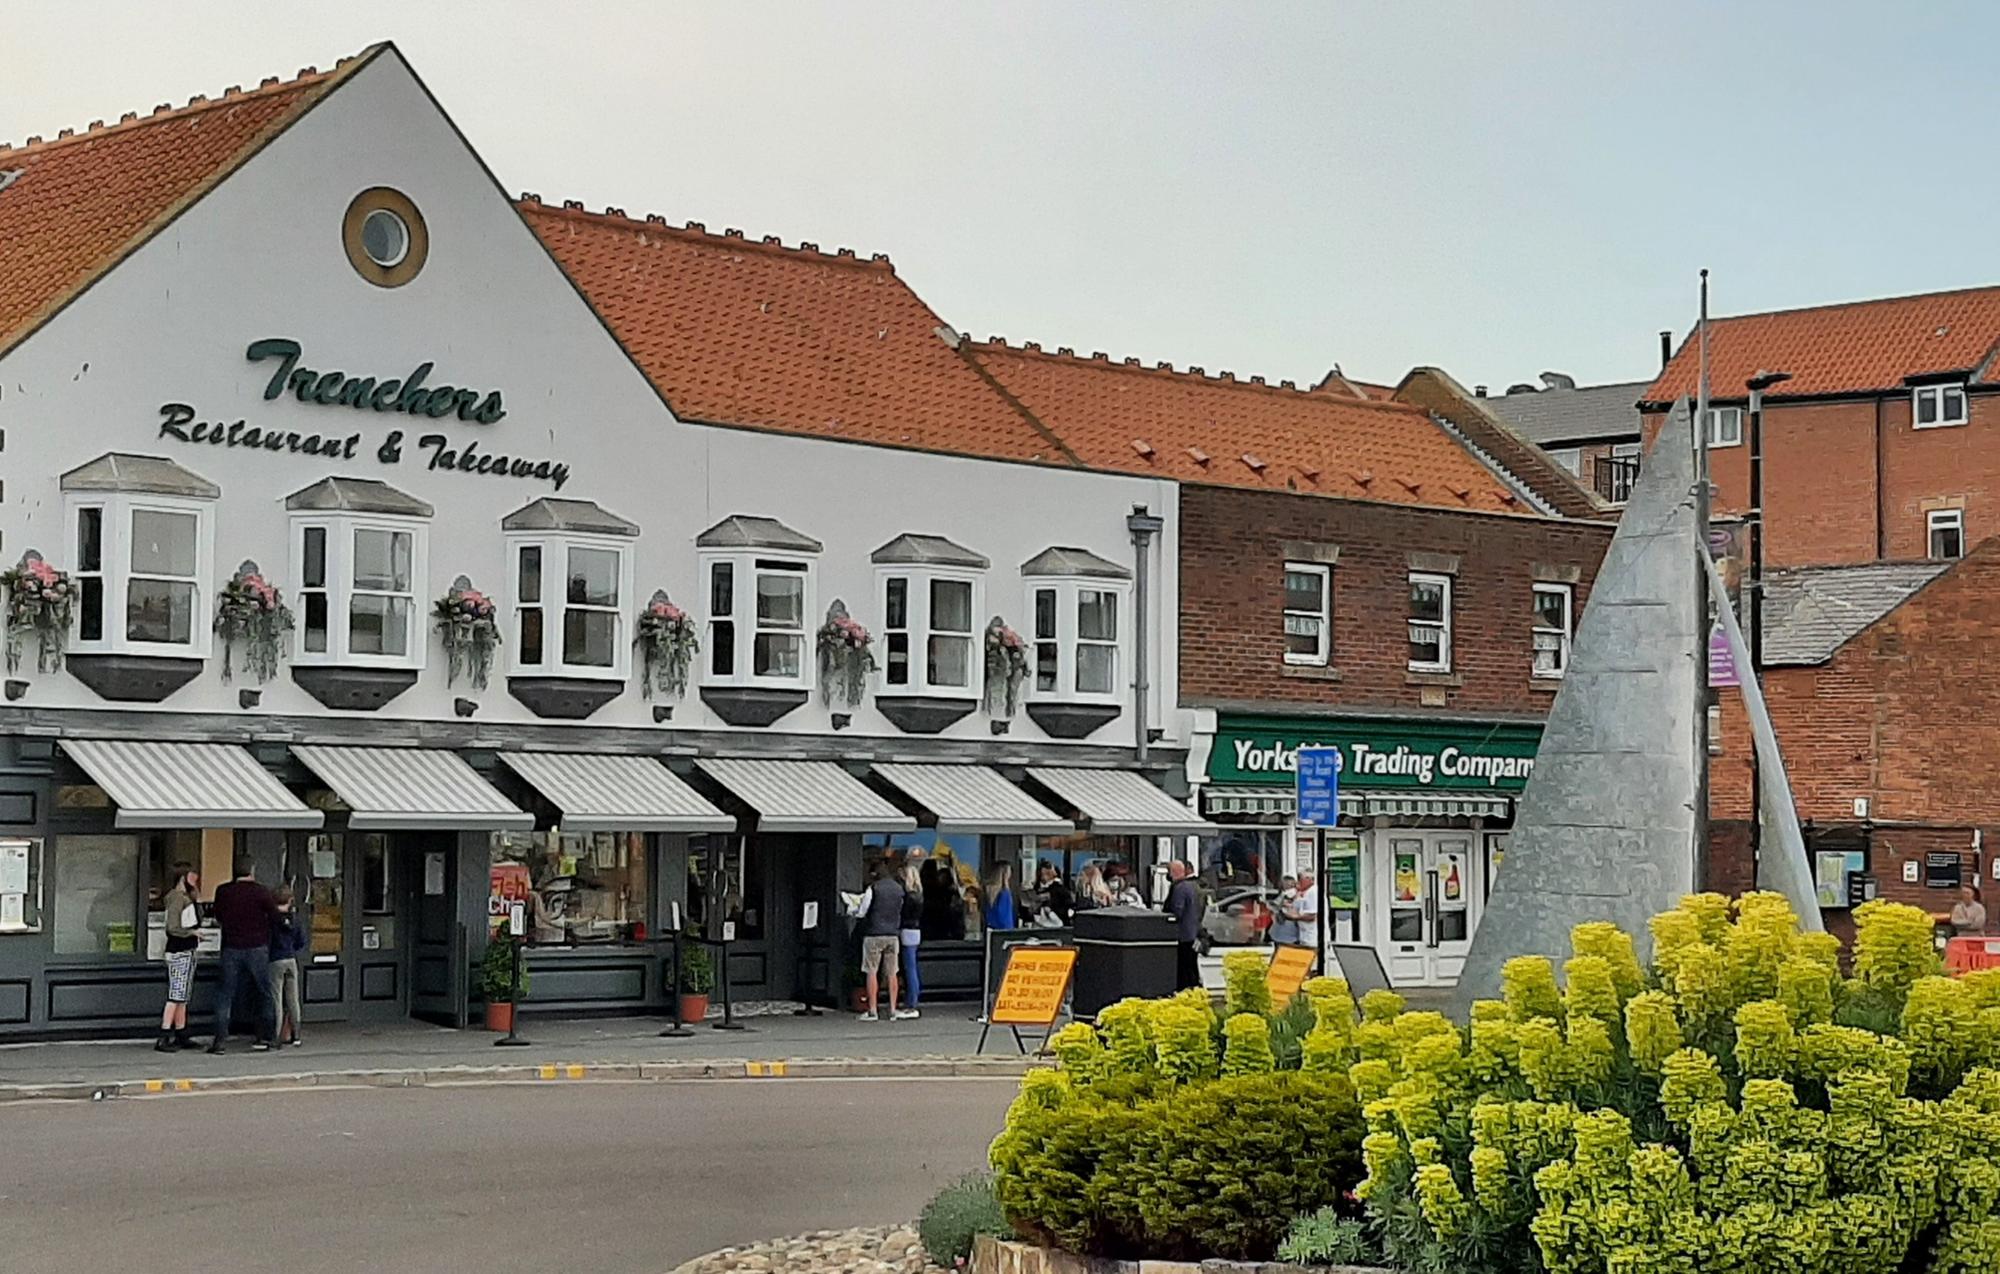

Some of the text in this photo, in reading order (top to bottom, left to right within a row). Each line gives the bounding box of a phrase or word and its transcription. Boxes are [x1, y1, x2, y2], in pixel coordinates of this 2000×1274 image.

[246, 338, 508, 425] Trenchers
[158, 403, 570, 490] Restaurant & Takeaway
[1234, 740, 1535, 786] Yorkse Trading Compan
